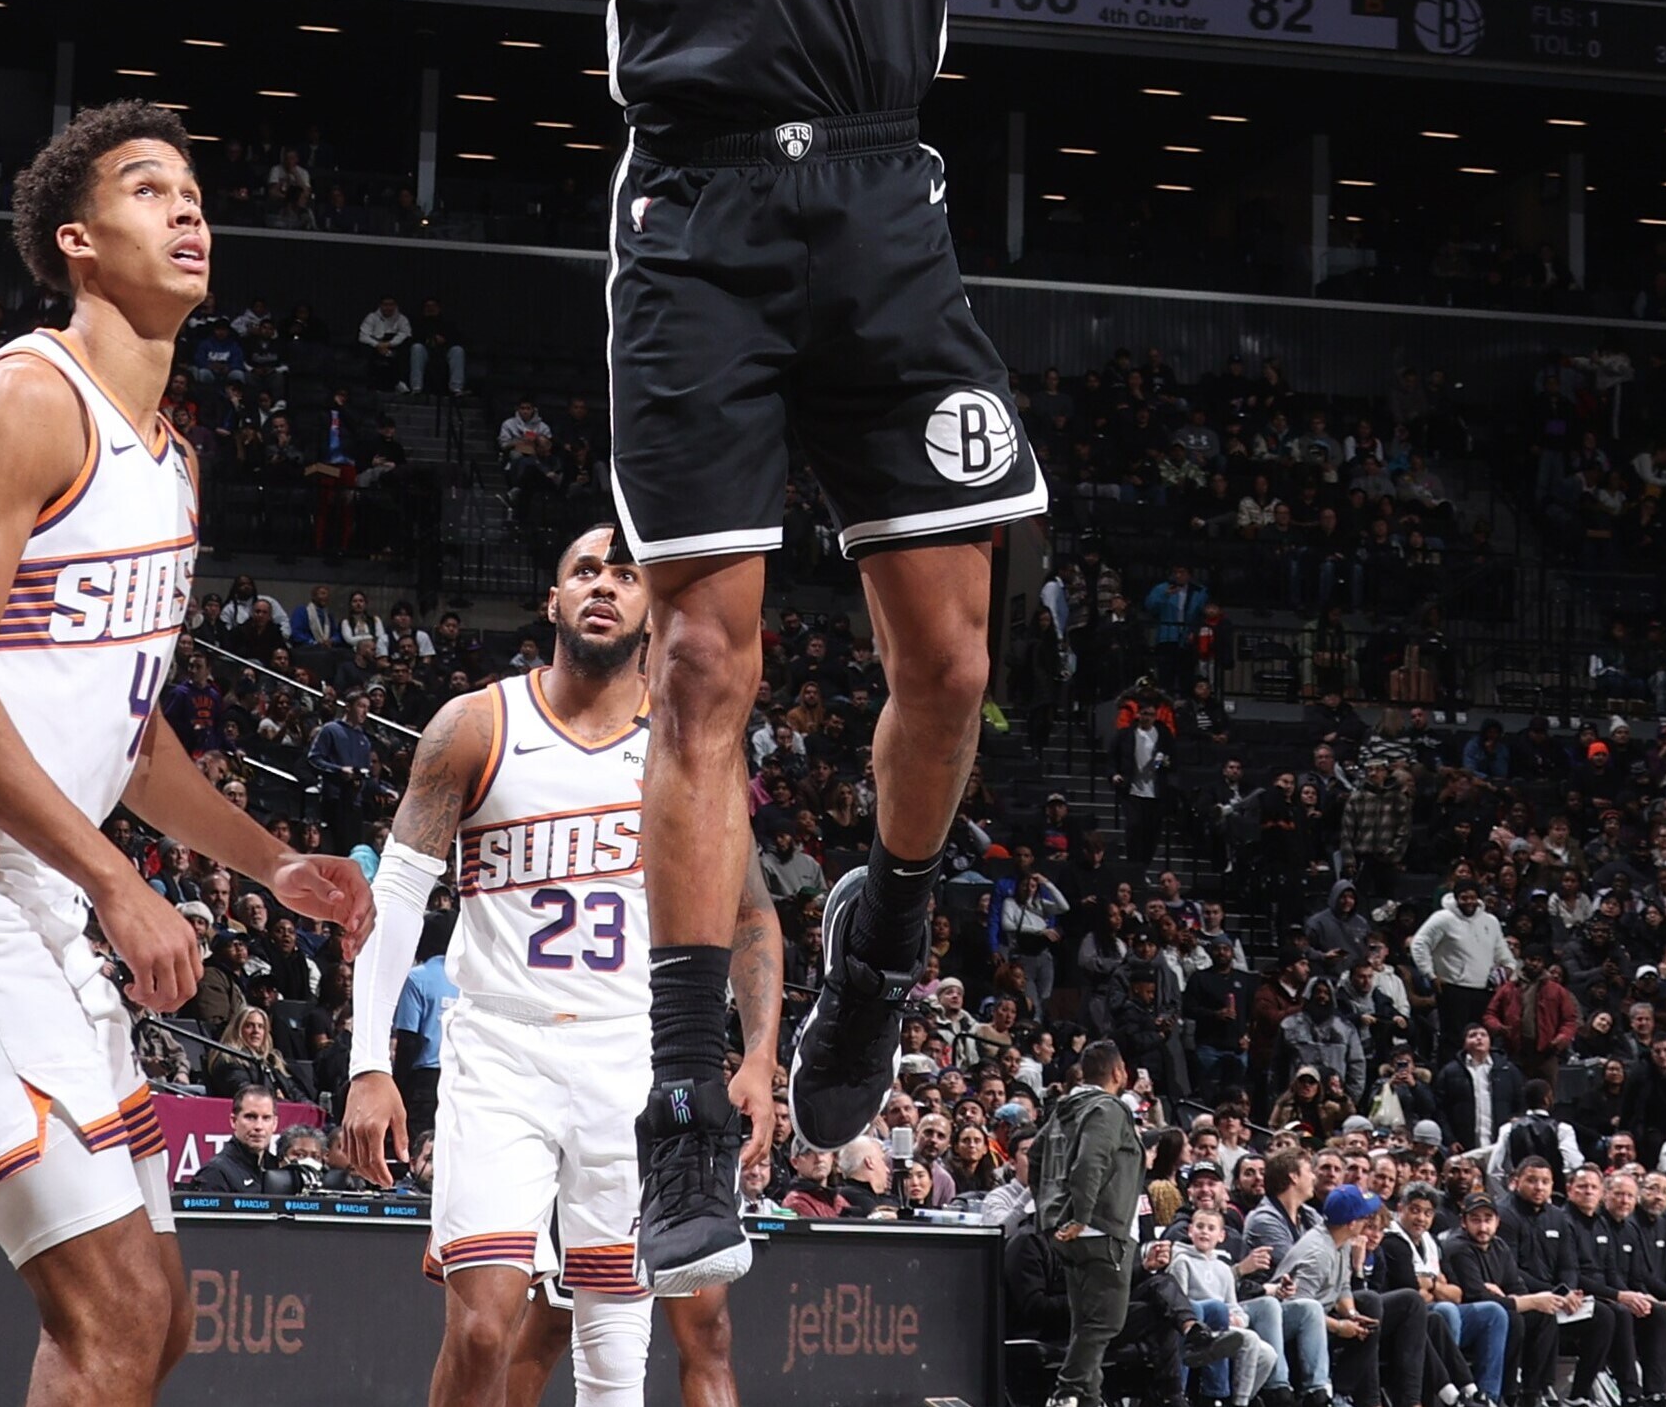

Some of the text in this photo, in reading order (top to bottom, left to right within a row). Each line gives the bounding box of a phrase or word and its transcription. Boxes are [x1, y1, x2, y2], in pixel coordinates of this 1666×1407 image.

[1098, 7, 1209, 31] 4th Quarter
[1529, 5, 1599, 29] FLS: 1
[1529, 34, 1603, 59] TOL: 0
[779, 125, 810, 143] NETS
[47, 550, 196, 643] SUNS
[128, 650, 165, 744] 4
[477, 812, 642, 891] SUNS
[527, 888, 626, 972] 23
[190, 1198, 220, 1208] BARCLAYS
[240, 1199, 270, 1209] BARCLAYS
[292, 1201, 320, 1212] BARCLAYS
[341, 1203, 369, 1214] BARCLAYS
[390, 1205, 418, 1216] BARCLAYS
[782, 1281, 920, 1374] jetBlue
